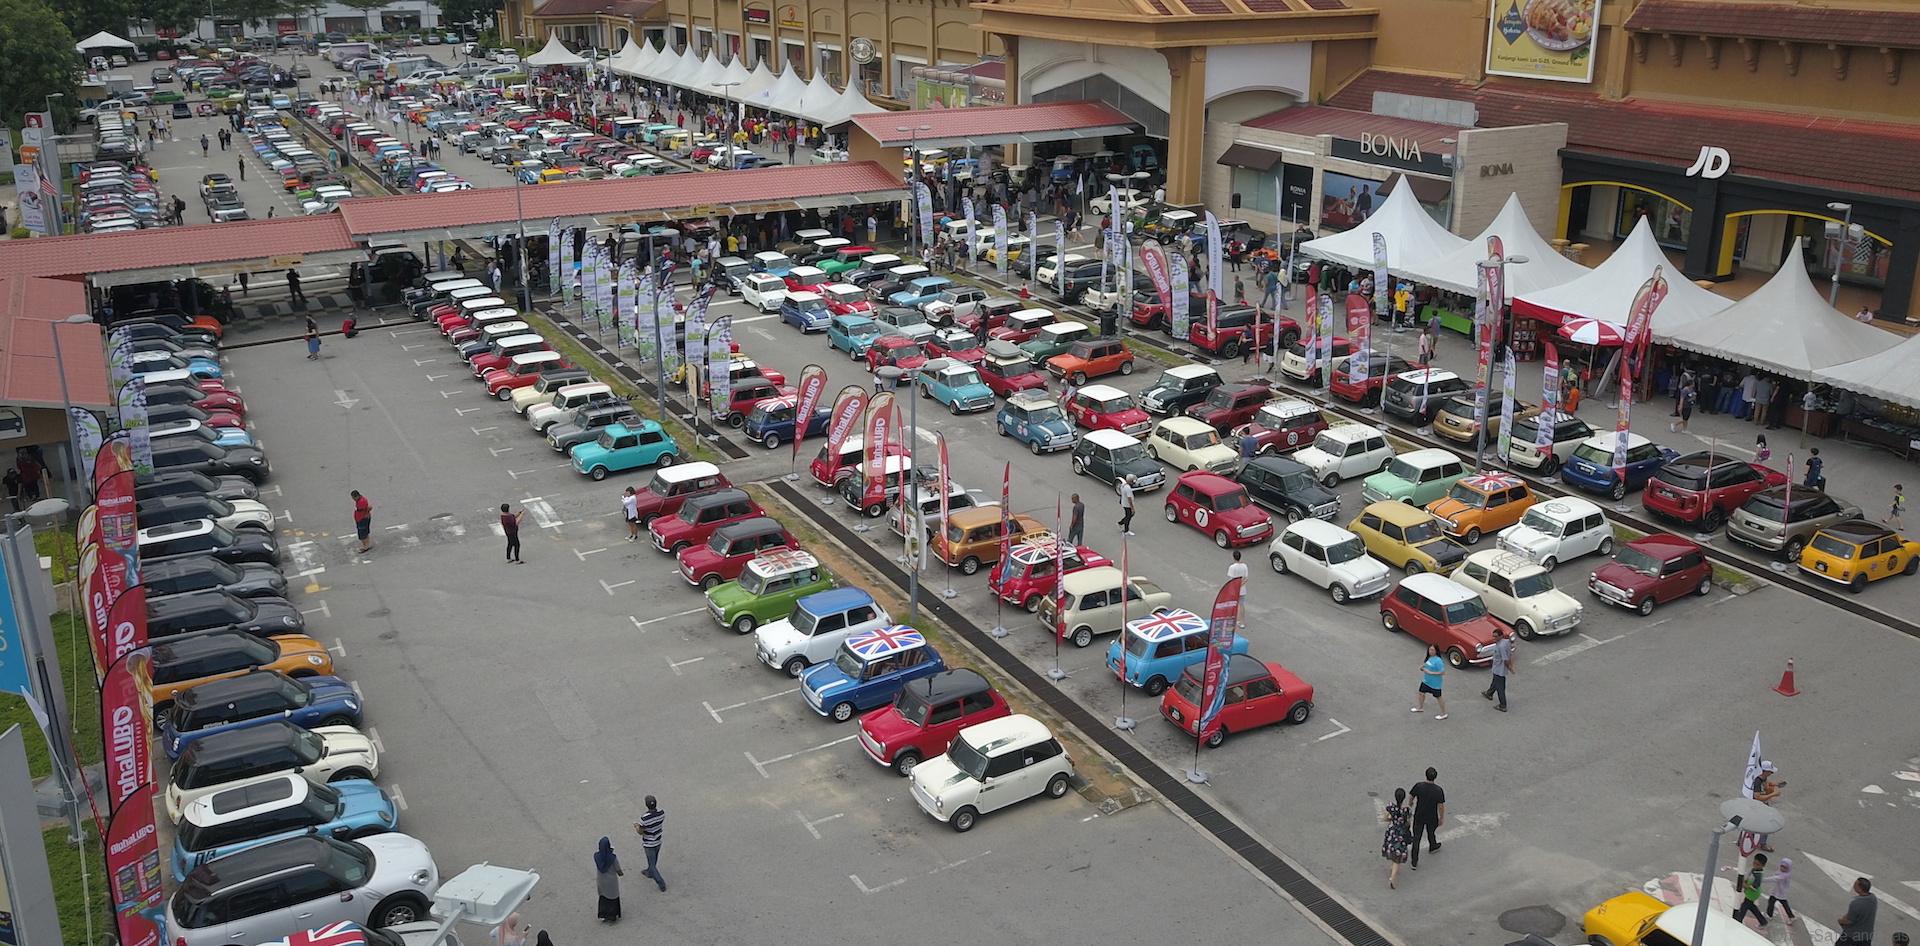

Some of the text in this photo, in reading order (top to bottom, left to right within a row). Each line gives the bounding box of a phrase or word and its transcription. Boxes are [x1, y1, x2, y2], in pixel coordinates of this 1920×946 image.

[1361, 132, 1422, 163] BONIA
[1479, 162, 1514, 178] BONIA
[1685, 145, 1731, 180] JD
[1199, 510, 1206, 523] 7
